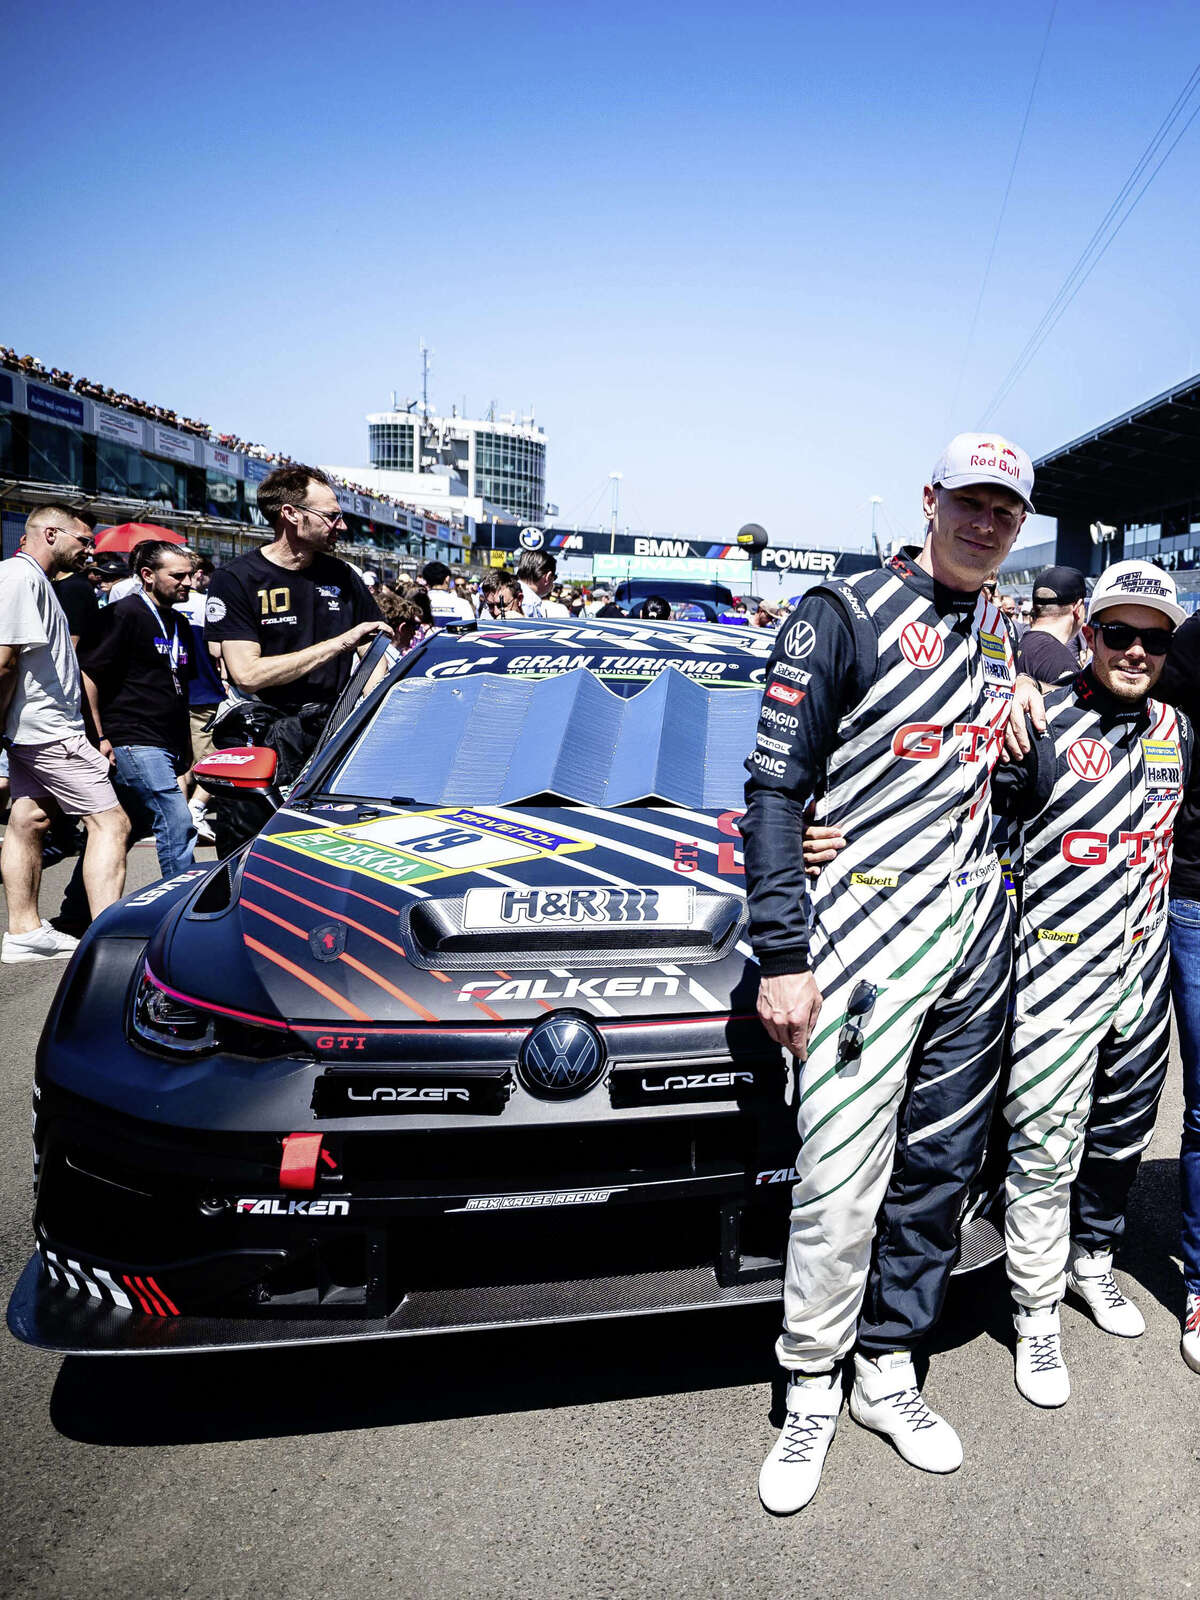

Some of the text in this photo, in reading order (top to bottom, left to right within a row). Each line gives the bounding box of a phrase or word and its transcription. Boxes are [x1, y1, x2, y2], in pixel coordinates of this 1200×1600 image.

[970, 454, 1021, 480] Red Bull
[634, 537, 690, 559] BMW
[761, 548, 837, 572] POWER
[257, 587, 291, 614] 10
[507, 655, 595, 669] GRAN
[776, 663, 809, 682] Sabelt
[984, 689, 1014, 700] FALKEN
[1147, 792, 1179, 802] FALKEN
[453, 812, 557, 846] RAVENOL
[395, 827, 484, 853] 19
[1061, 828, 1174, 867] GTI
[319, 843, 422, 879] DEKRA
[673, 841, 699, 873] GTI
[124, 869, 208, 907] FALKEN
[855, 873, 893, 888] Sabelt
[1041, 930, 1074, 942] Sabelt
[453, 975, 682, 1002] FALKEN
[316, 1036, 367, 1050] GTI
[642, 1071, 754, 1092] LAZER
[347, 1086, 470, 1101] LAZER
[755, 1168, 801, 1186] FAL
[234, 1199, 350, 1216] FALKEN
[465, 1190, 611, 1211] MAX KRUSE RACING
